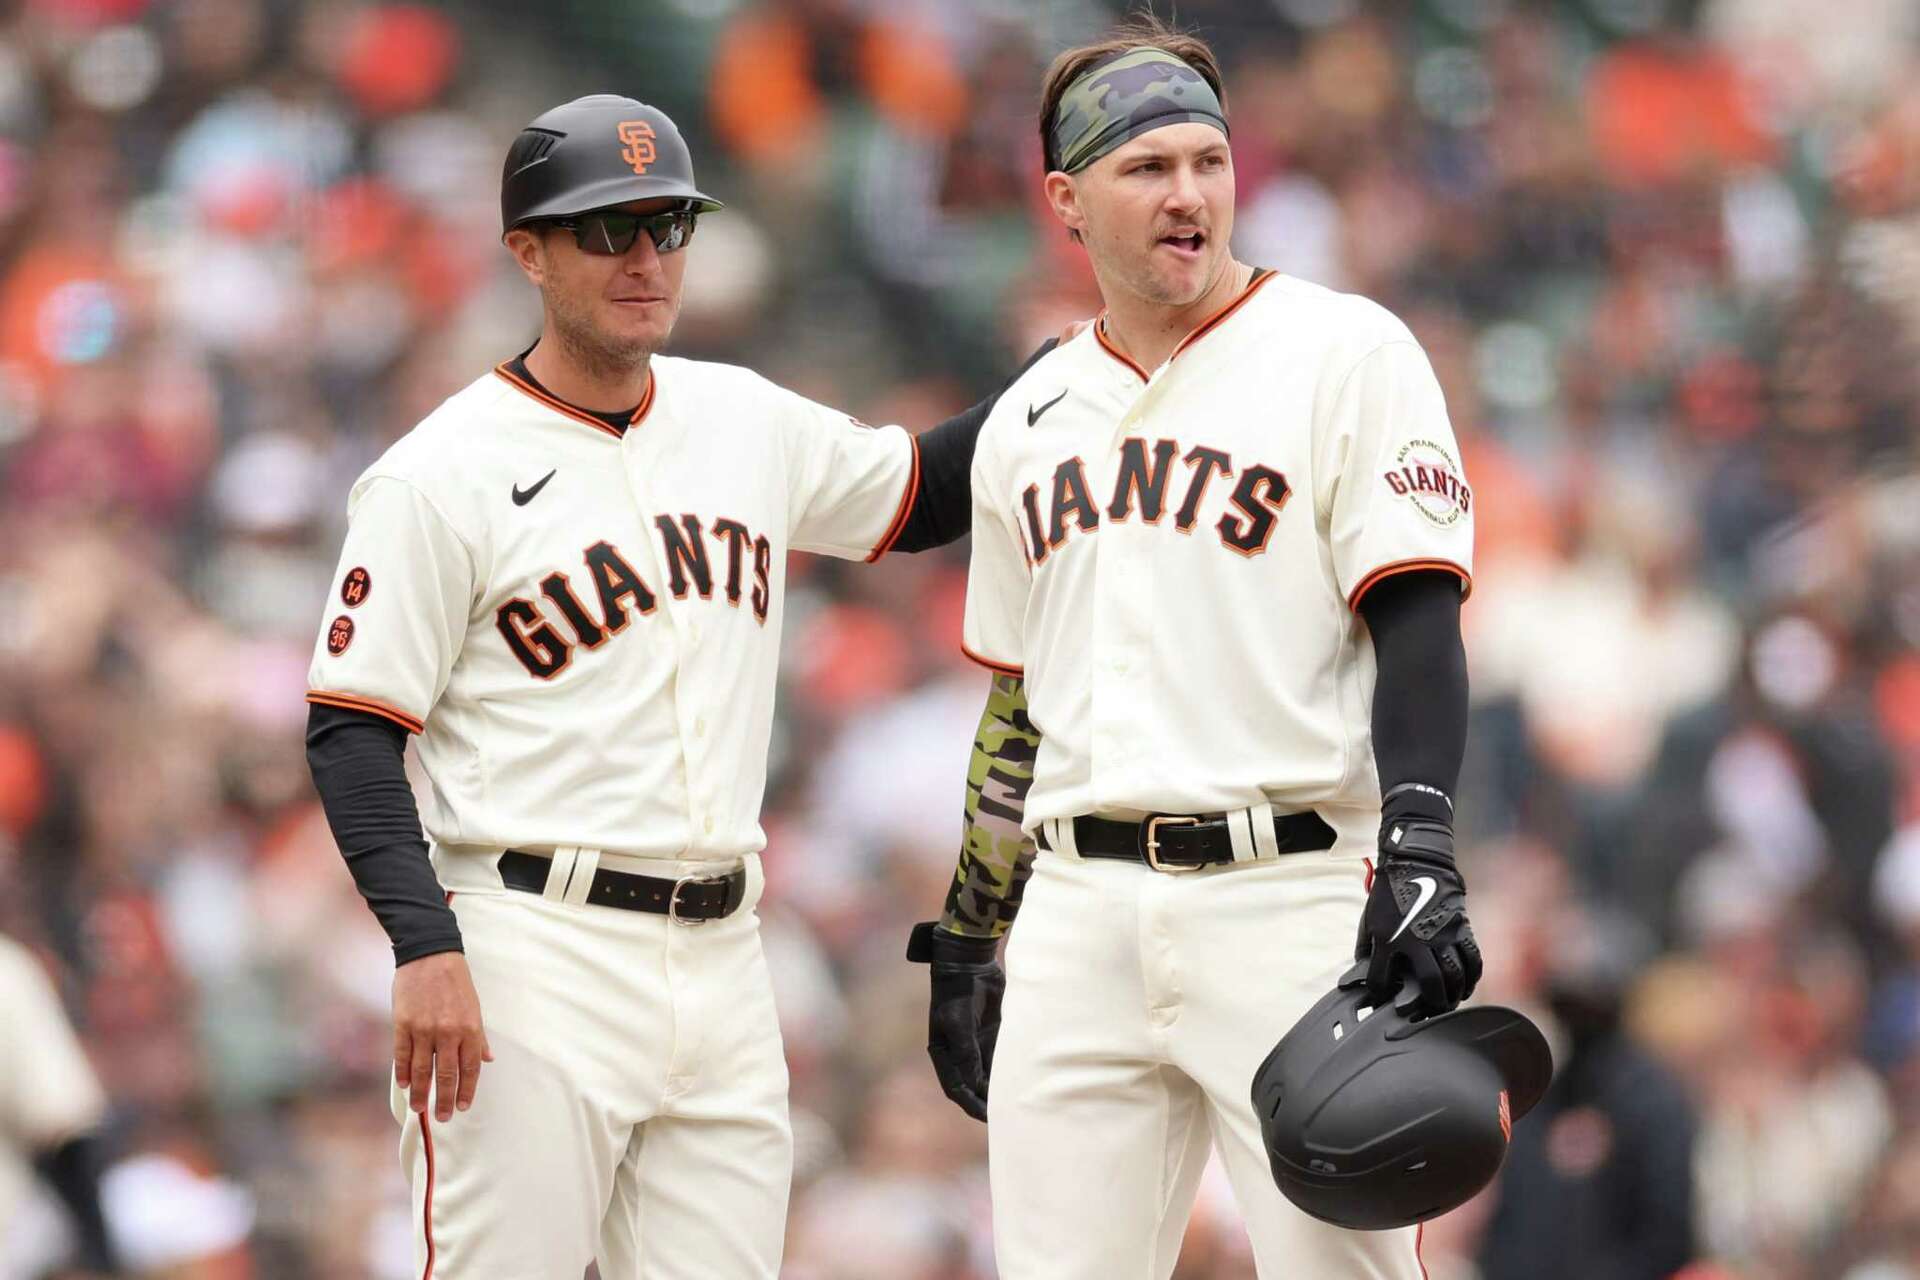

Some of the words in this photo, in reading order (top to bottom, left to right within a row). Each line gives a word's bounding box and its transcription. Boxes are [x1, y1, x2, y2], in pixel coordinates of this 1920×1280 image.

[617, 120, 656, 175] SF
[1019, 437, 1293, 567] IANTS
[1384, 465, 1471, 514] GIANTS
[346, 580, 363, 602] 14
[496, 513, 771, 681] GIANTS
[329, 629, 348, 648] 36
